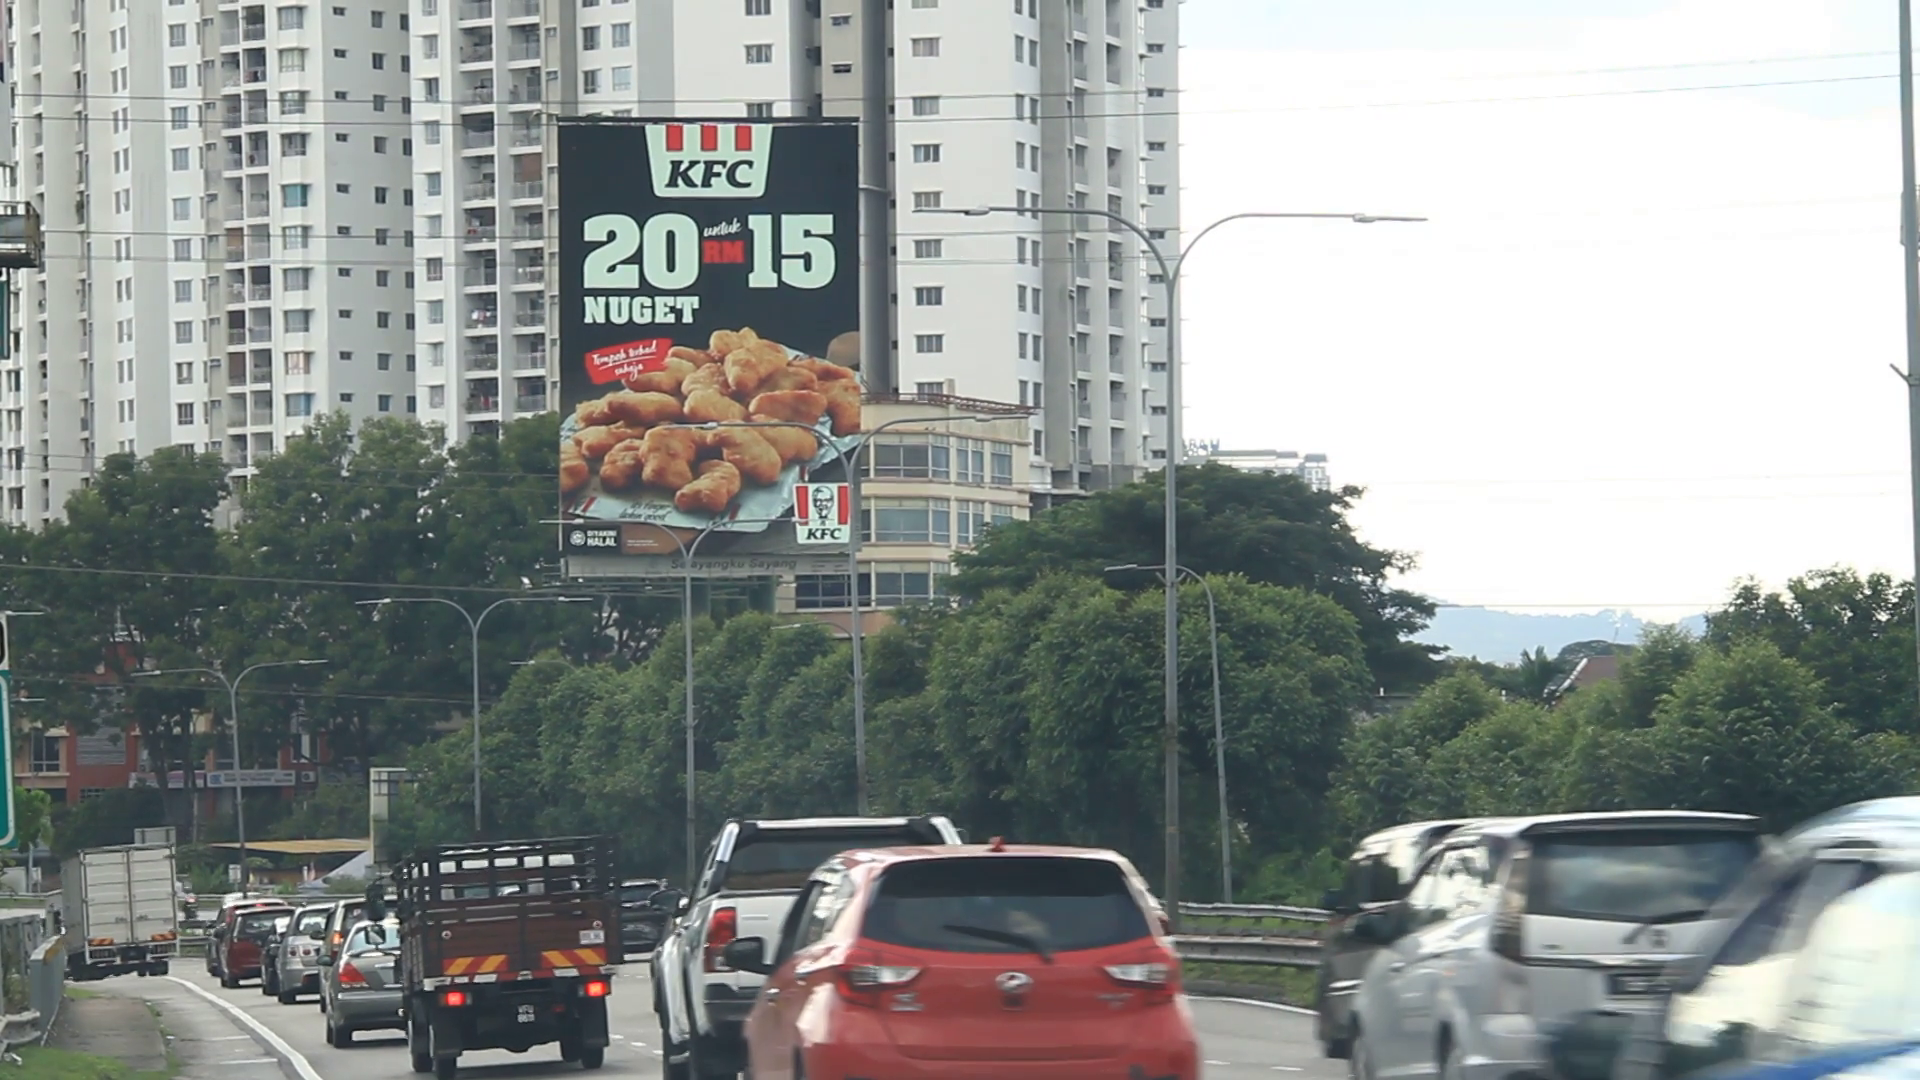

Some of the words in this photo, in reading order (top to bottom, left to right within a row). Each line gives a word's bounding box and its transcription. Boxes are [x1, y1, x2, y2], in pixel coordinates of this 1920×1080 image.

[665, 160, 754, 188] KFC
[703, 218, 742, 237] untuk
[583, 213, 699, 290] 20
[703, 240, 744, 263] RM
[748, 214, 836, 289] 15
[583, 296, 699, 325] NUGET
[591, 348, 627, 366] Tempoh
[628, 340, 656, 357] terhad
[614, 362, 643, 382] sahaja
[587, 537, 617, 547] HALAL
[806, 528, 842, 540] KFC
[671, 559, 745, 571] Seayangku
[750, 559, 797, 571] Sayang
